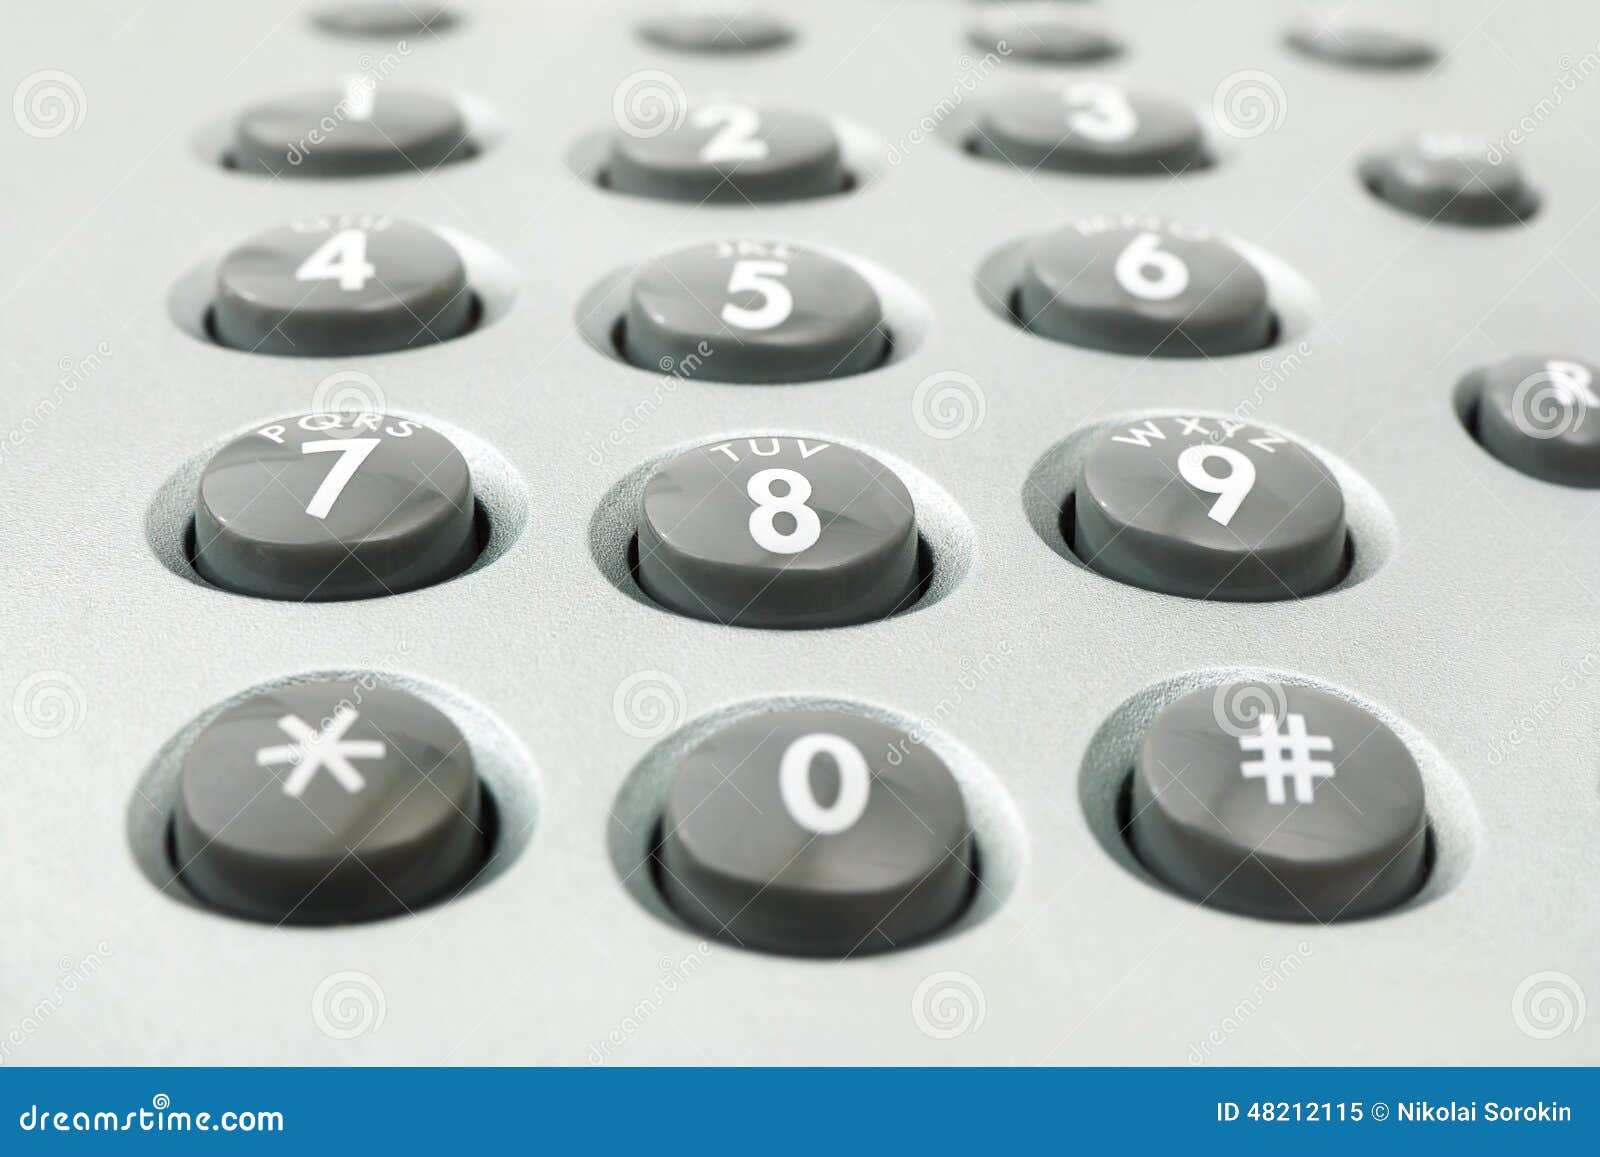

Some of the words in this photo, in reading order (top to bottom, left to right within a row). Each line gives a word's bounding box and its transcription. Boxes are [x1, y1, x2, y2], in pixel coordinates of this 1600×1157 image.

[344, 74, 377, 121] 1
[1064, 82, 1139, 142] 3
[695, 102, 767, 161] 2
[295, 229, 375, 291] 4
[1115, 233, 1189, 300] 6
[721, 259, 793, 330] 5
[1545, 361, 1600, 408] R
[257, 413, 423, 444] PQRS
[709, 437, 830, 462] TUV
[301, 438, 381, 520] 7
[747, 468, 821, 554] 8
[1177, 444, 1256, 527] 9
[779, 732, 870, 835] 0
[1239, 713, 1336, 805] #
